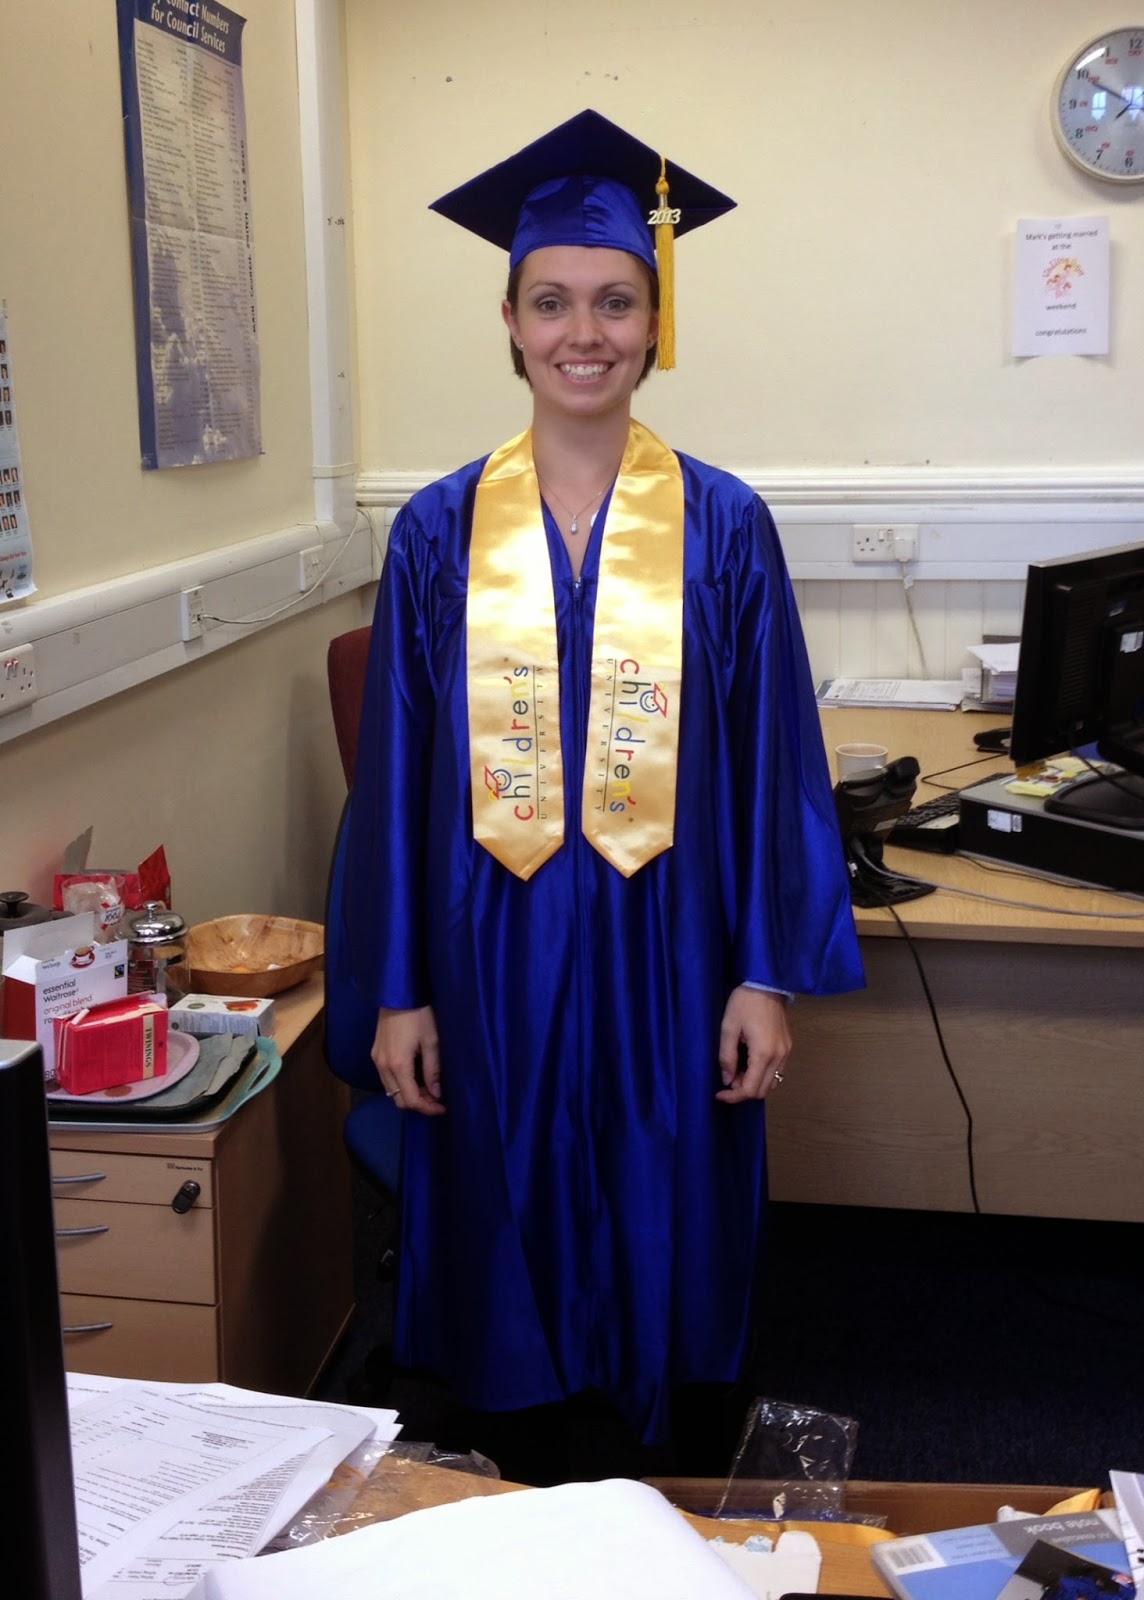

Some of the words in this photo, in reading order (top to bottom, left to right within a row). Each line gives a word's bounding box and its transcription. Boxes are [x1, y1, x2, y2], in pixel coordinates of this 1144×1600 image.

[166, 0, 199, 17] ontact
[201, 4, 230, 34] Numbers
[151, 4, 165, 23] for
[166, 14, 199, 40] Council
[200, 29, 226, 54] Services
[1129, 38, 1143, 50] 12
[1076, 69, 1089, 80] 10
[1068, 98, 1077, 110] 9
[1075, 128, 1084, 139] 8
[1096, 149, 1104, 161] 7
[1124, 157, 1134, 168] 6
[647, 208, 682, 225] 2013
[1048, 232, 1072, 241] getting
[1072, 230, 1098, 238] married
[1045, 303, 1077, 311] weekend
[1035, 327, 1087, 337] congratulations
[594, 658, 614, 812] UNIVERSITY
[537, 666, 548, 820] UNIVERSITY
[43, 979, 76, 995] essential
[43, 989, 77, 1003] Waitrose
[43, 999, 72, 1017] original
[73, 994, 93, 1008] blend
[145, 1027, 153, 1068] TWININGS
[1023, 1521, 1064, 1535] book
